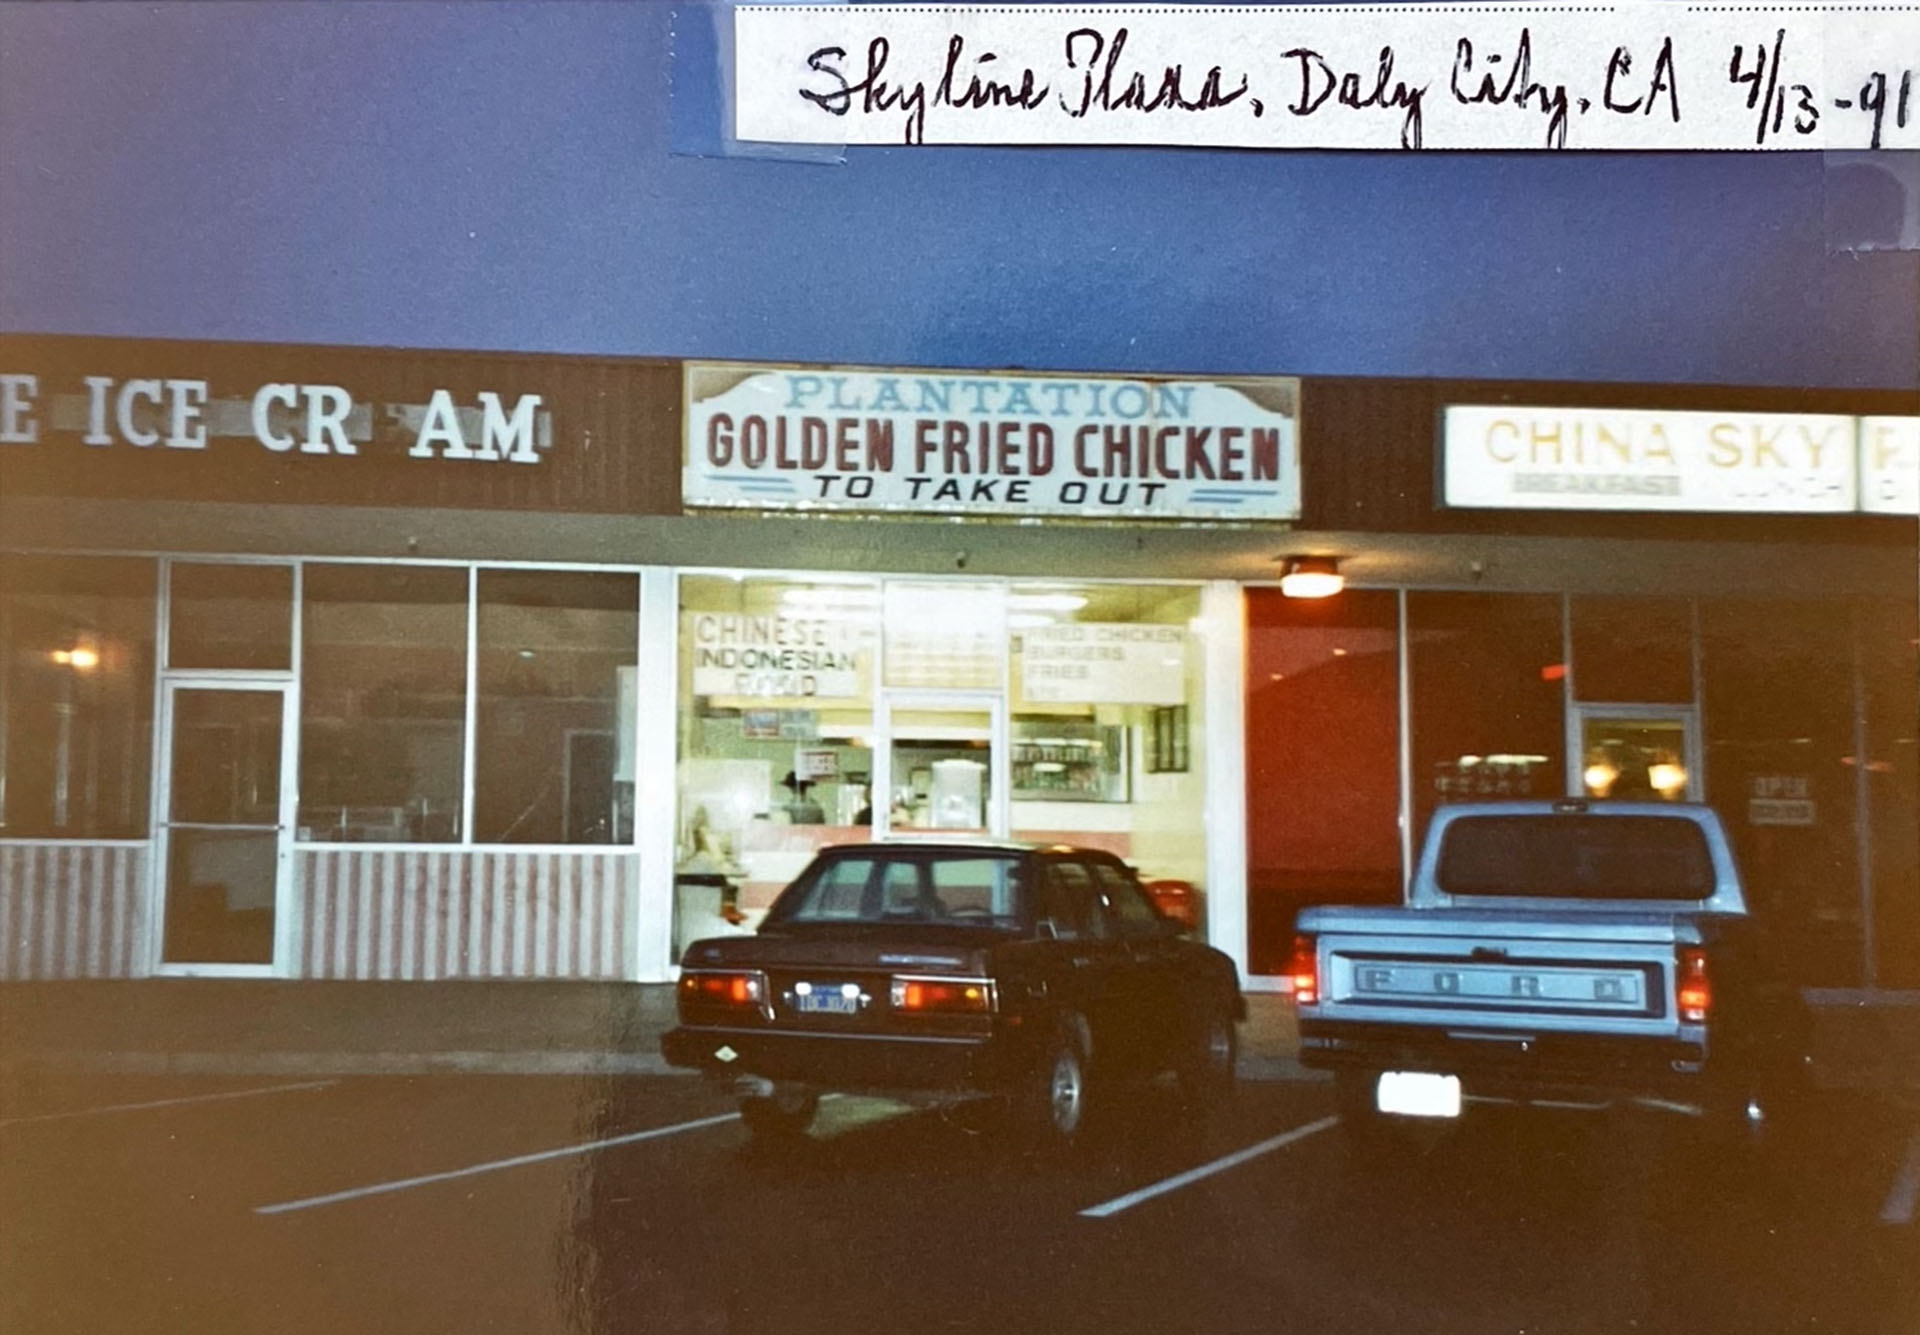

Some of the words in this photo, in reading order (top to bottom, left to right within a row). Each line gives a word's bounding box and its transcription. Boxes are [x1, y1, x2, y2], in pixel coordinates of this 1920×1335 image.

[800, 36, 1049, 145] Skyline
[1281, 46, 1427, 149] Daly
[1605, 37, 1680, 123] CA
[83, 377, 207, 448] ICE
[785, 375, 1195, 419] PLANTATION
[707, 413, 893, 472] GOLDEN
[915, 420, 1054, 476] FRIED
[1074, 423, 1280, 481] CHICKEN
[1485, 419, 1676, 464] CHINA
[1707, 423, 1840, 468] SKY
[813, 475, 874, 499] TO
[904, 477, 1031, 503] TAKE
[1058, 481, 1167, 505] OUT
[697, 615, 827, 647] CHINESE
[1364, 968, 1622, 1001] FORD
